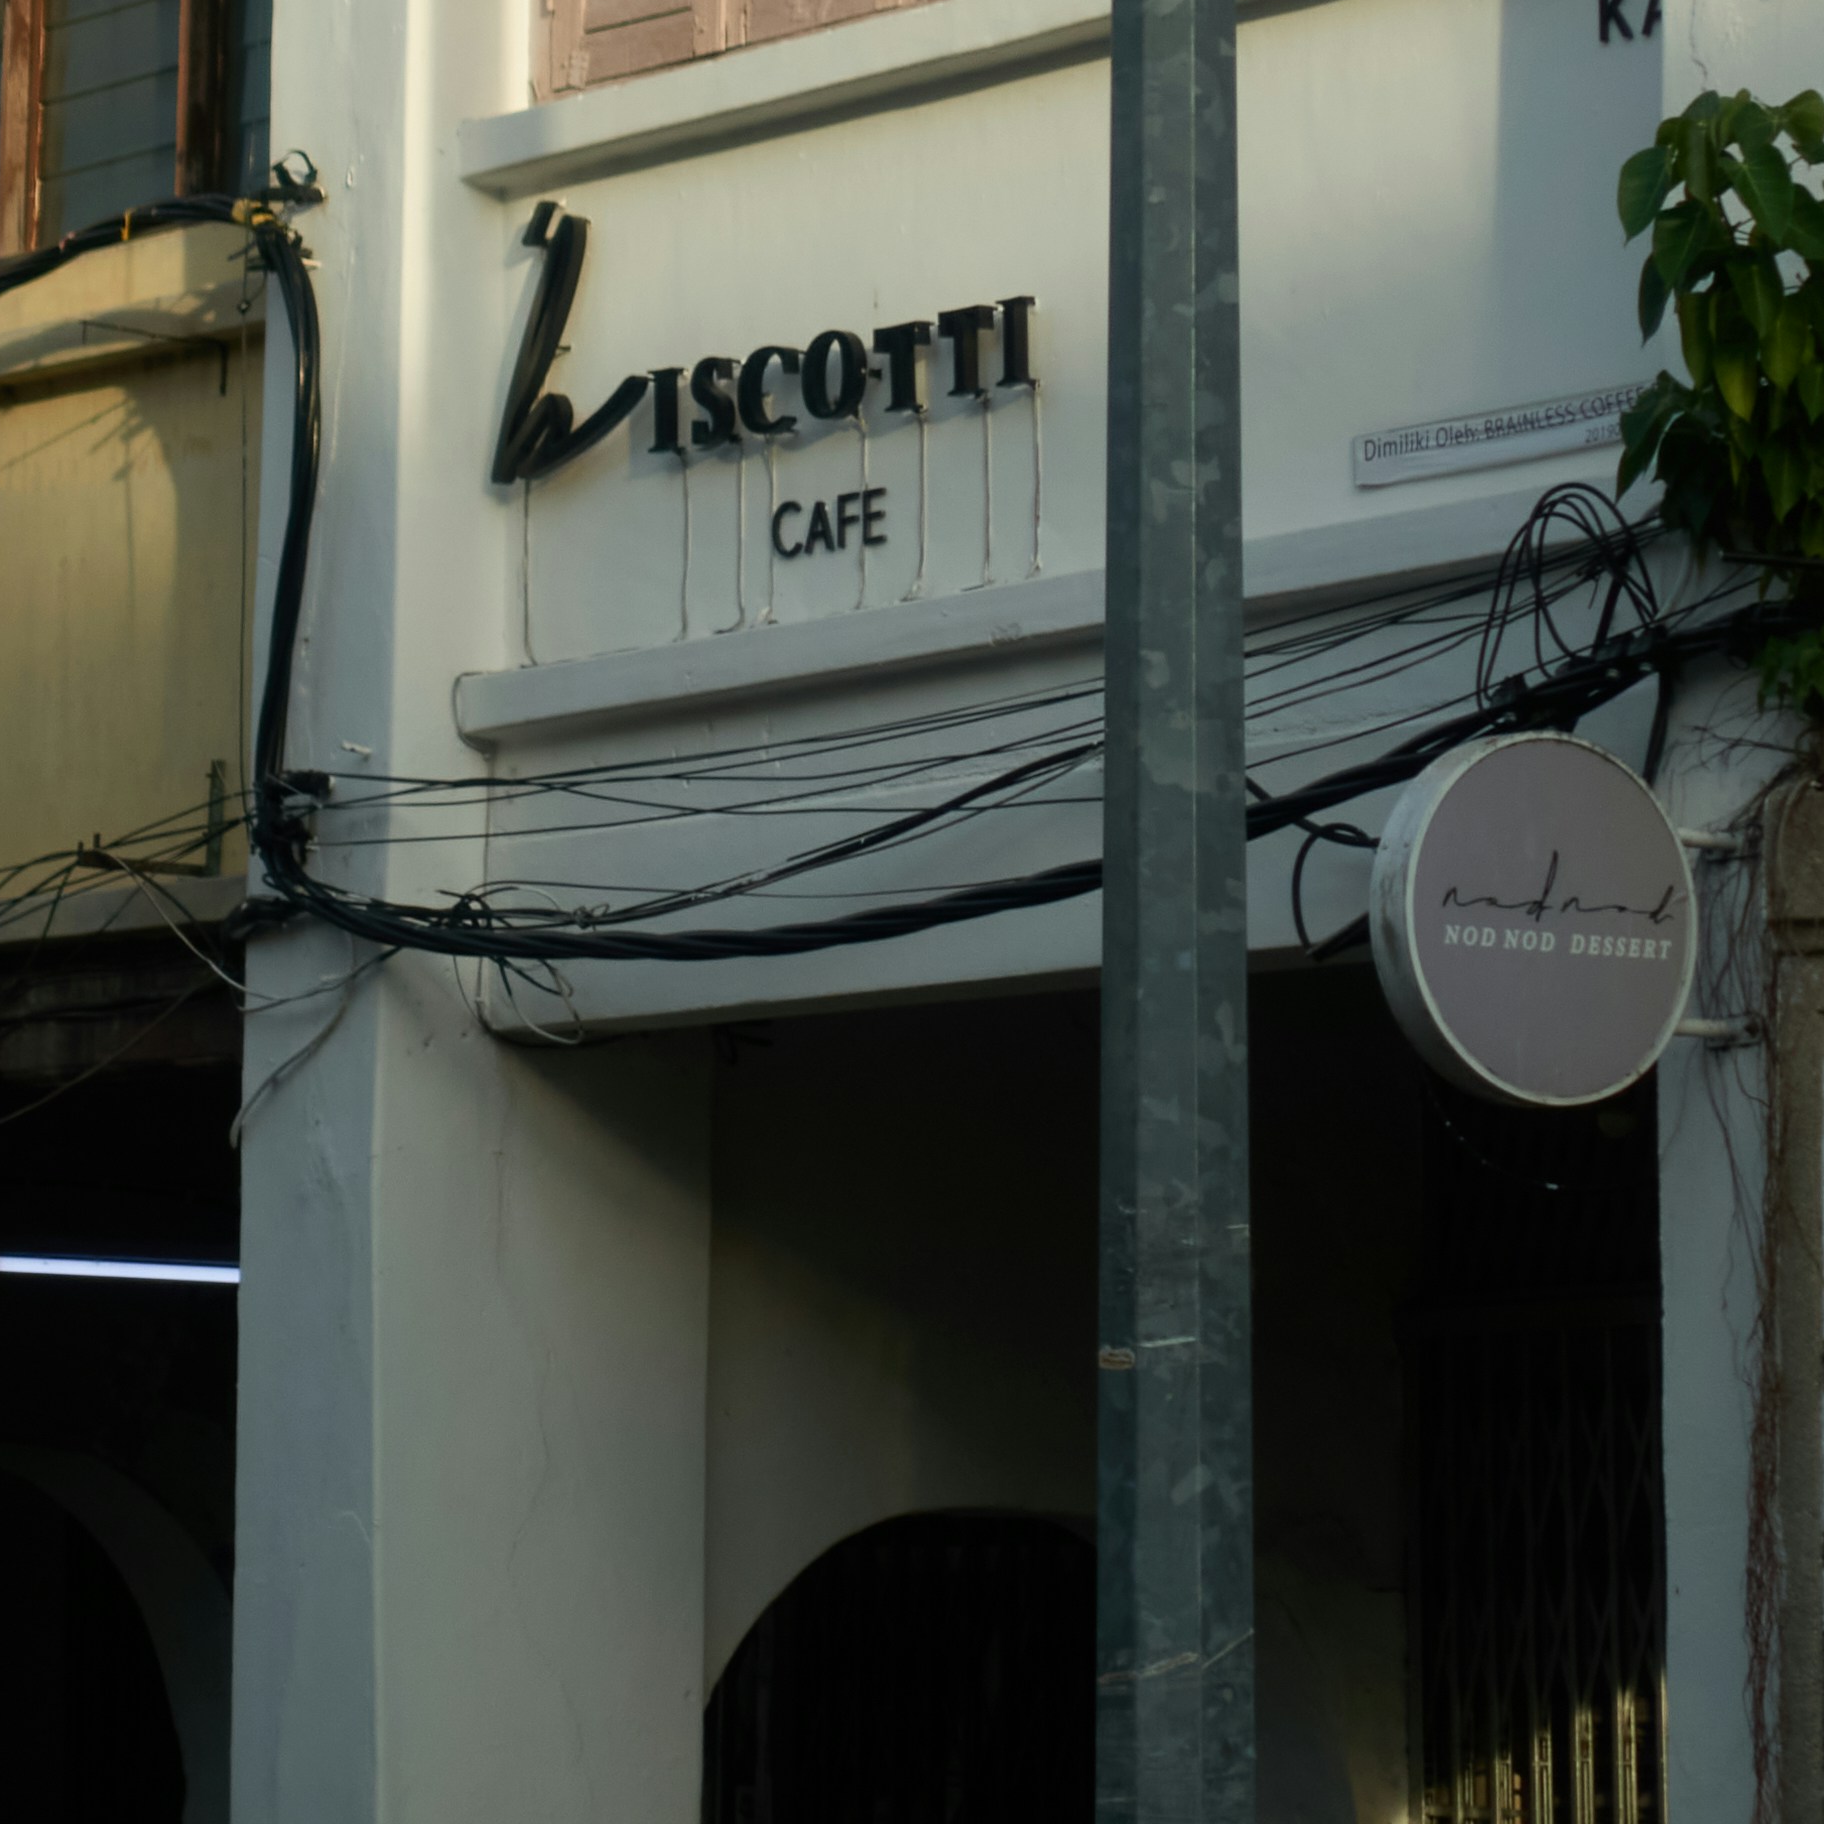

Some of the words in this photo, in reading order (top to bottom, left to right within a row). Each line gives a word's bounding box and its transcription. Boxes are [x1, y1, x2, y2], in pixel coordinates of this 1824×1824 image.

[1364, 434, 1429, 461] Dimiliki
[1435, 426, 1480, 449] Oleh:
[1484, 401, 1576, 439] BRAINLESS
[1580, 385, 1644, 419] COFFE
[771, 487, 887, 557] CAFE
[1444, 924, 1496, 948] NOD
[1504, 928, 1556, 952] NOD
[1570, 934, 1673, 960] DESSERT
